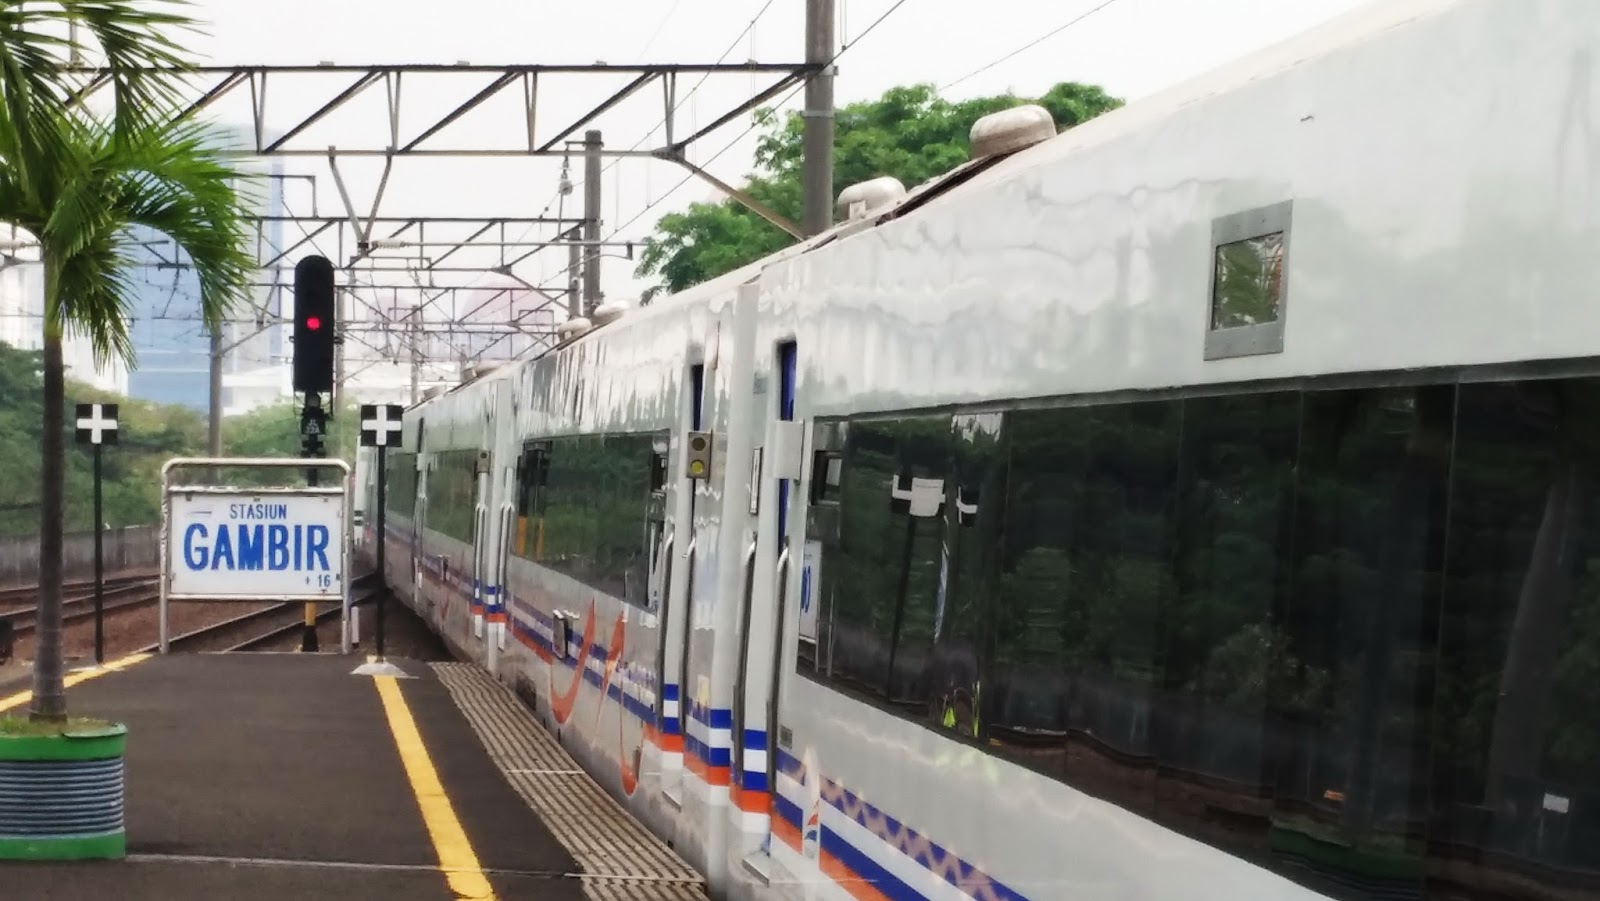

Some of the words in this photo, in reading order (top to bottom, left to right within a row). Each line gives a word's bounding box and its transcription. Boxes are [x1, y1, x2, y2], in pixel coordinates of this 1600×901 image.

[230, 504, 287, 520] STASIUN
[184, 523, 330, 571] GAMBIR
[318, 574, 331, 587] 16
